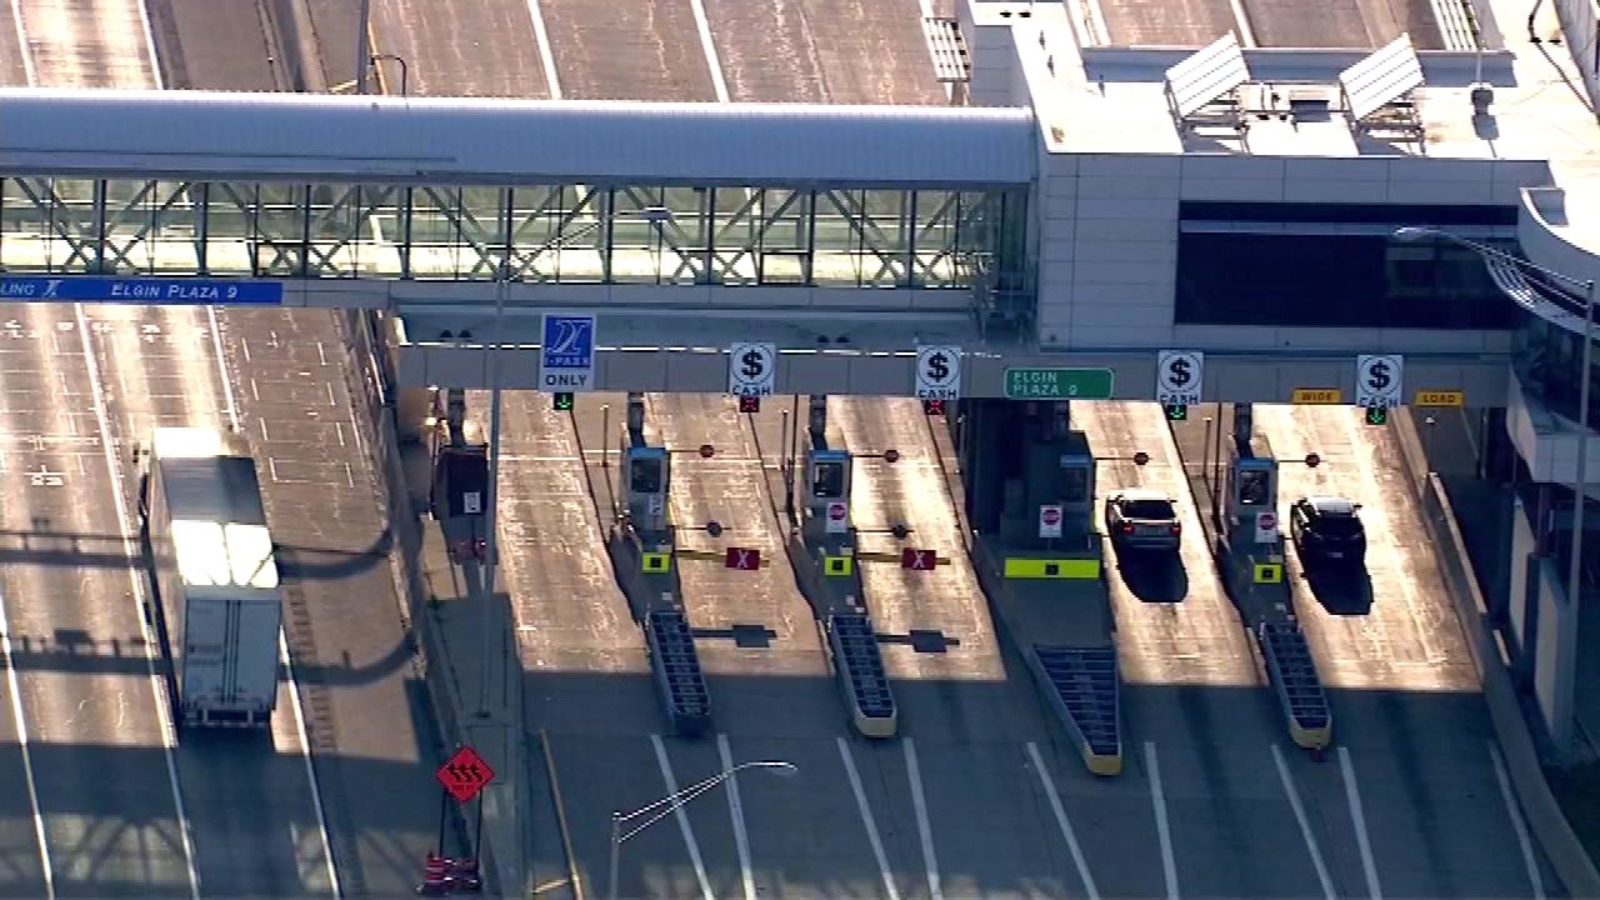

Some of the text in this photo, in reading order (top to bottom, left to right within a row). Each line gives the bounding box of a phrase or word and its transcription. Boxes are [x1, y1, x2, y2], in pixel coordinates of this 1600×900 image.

[111, 281, 238, 298] ELGIN PLAZA 9
[545, 374, 587, 386] ONLY
[1013, 371, 1058, 383] ELGIN
[732, 384, 771, 396] CASH
[919, 389, 957, 399] CASH
[1013, 384, 1079, 396] PLAZA 9
[1160, 394, 1199, 405] CASH
[1301, 392, 1332, 402] WIDE
[1360, 396, 1398, 407] CASH
[1423, 394, 1456, 404] LOAD
